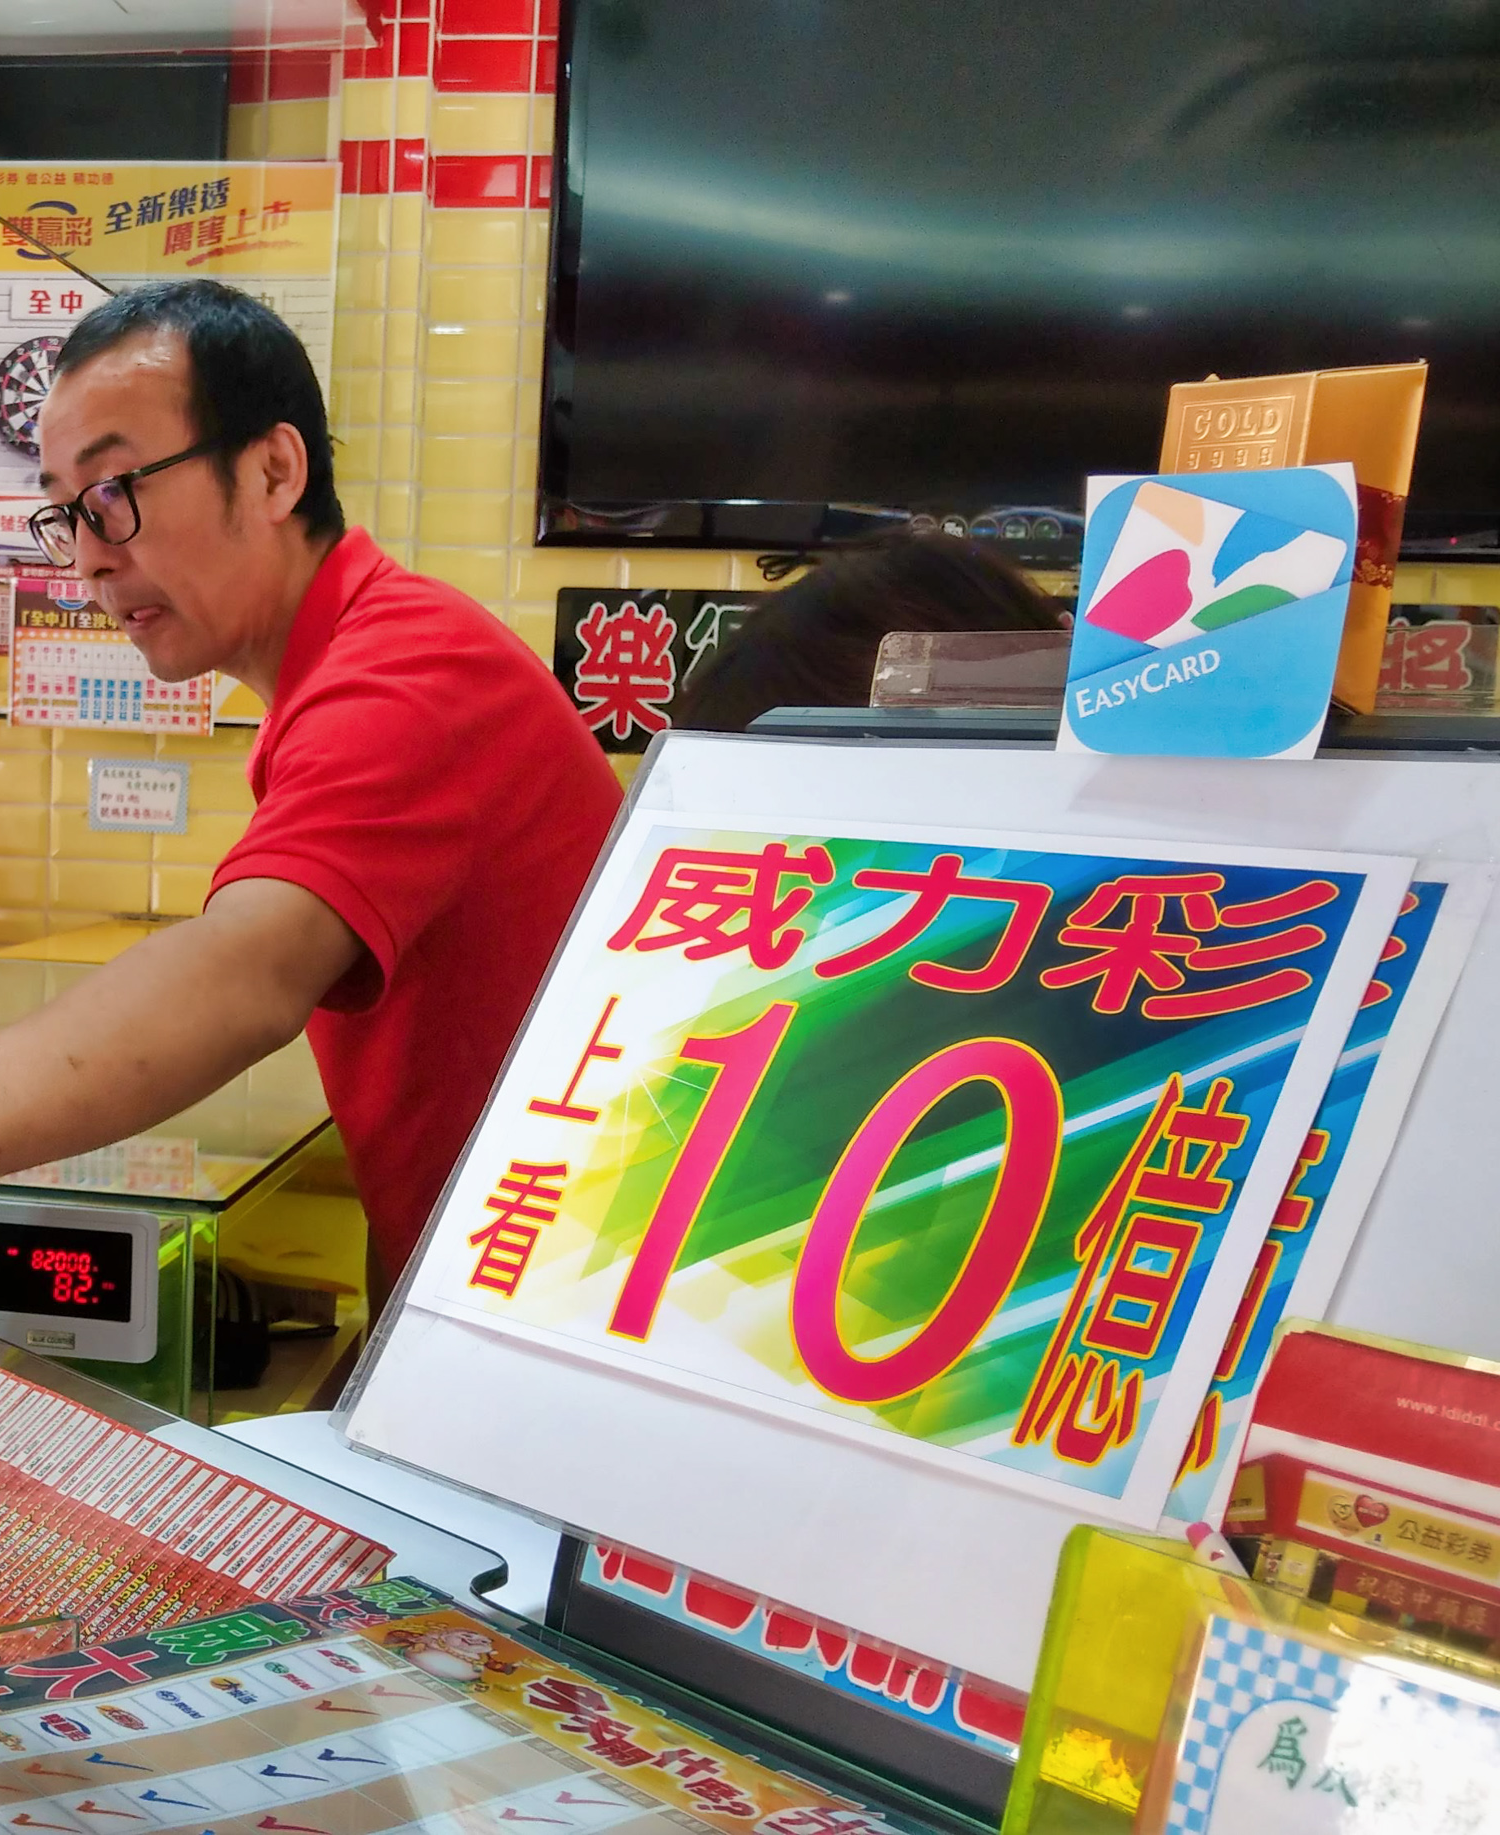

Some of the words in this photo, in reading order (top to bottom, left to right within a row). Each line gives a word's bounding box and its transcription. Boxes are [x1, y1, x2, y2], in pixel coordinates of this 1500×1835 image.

[2, 217, 93, 246] 雙贏彩
[105, 177, 231, 235] 全新樂透
[163, 200, 293, 256] 厲害上市
[28, 290, 83, 314] 全中
[1194, 404, 1284, 440] GOLD
[607, 841, 1339, 1021] 威力彩
[468, 995, 625, 1300] 上看
[606, 999, 1065, 1408] 10
[1011, 1071, 1251, 1468] 億
[1397, 1518, 1492, 1564] 公益彩券
